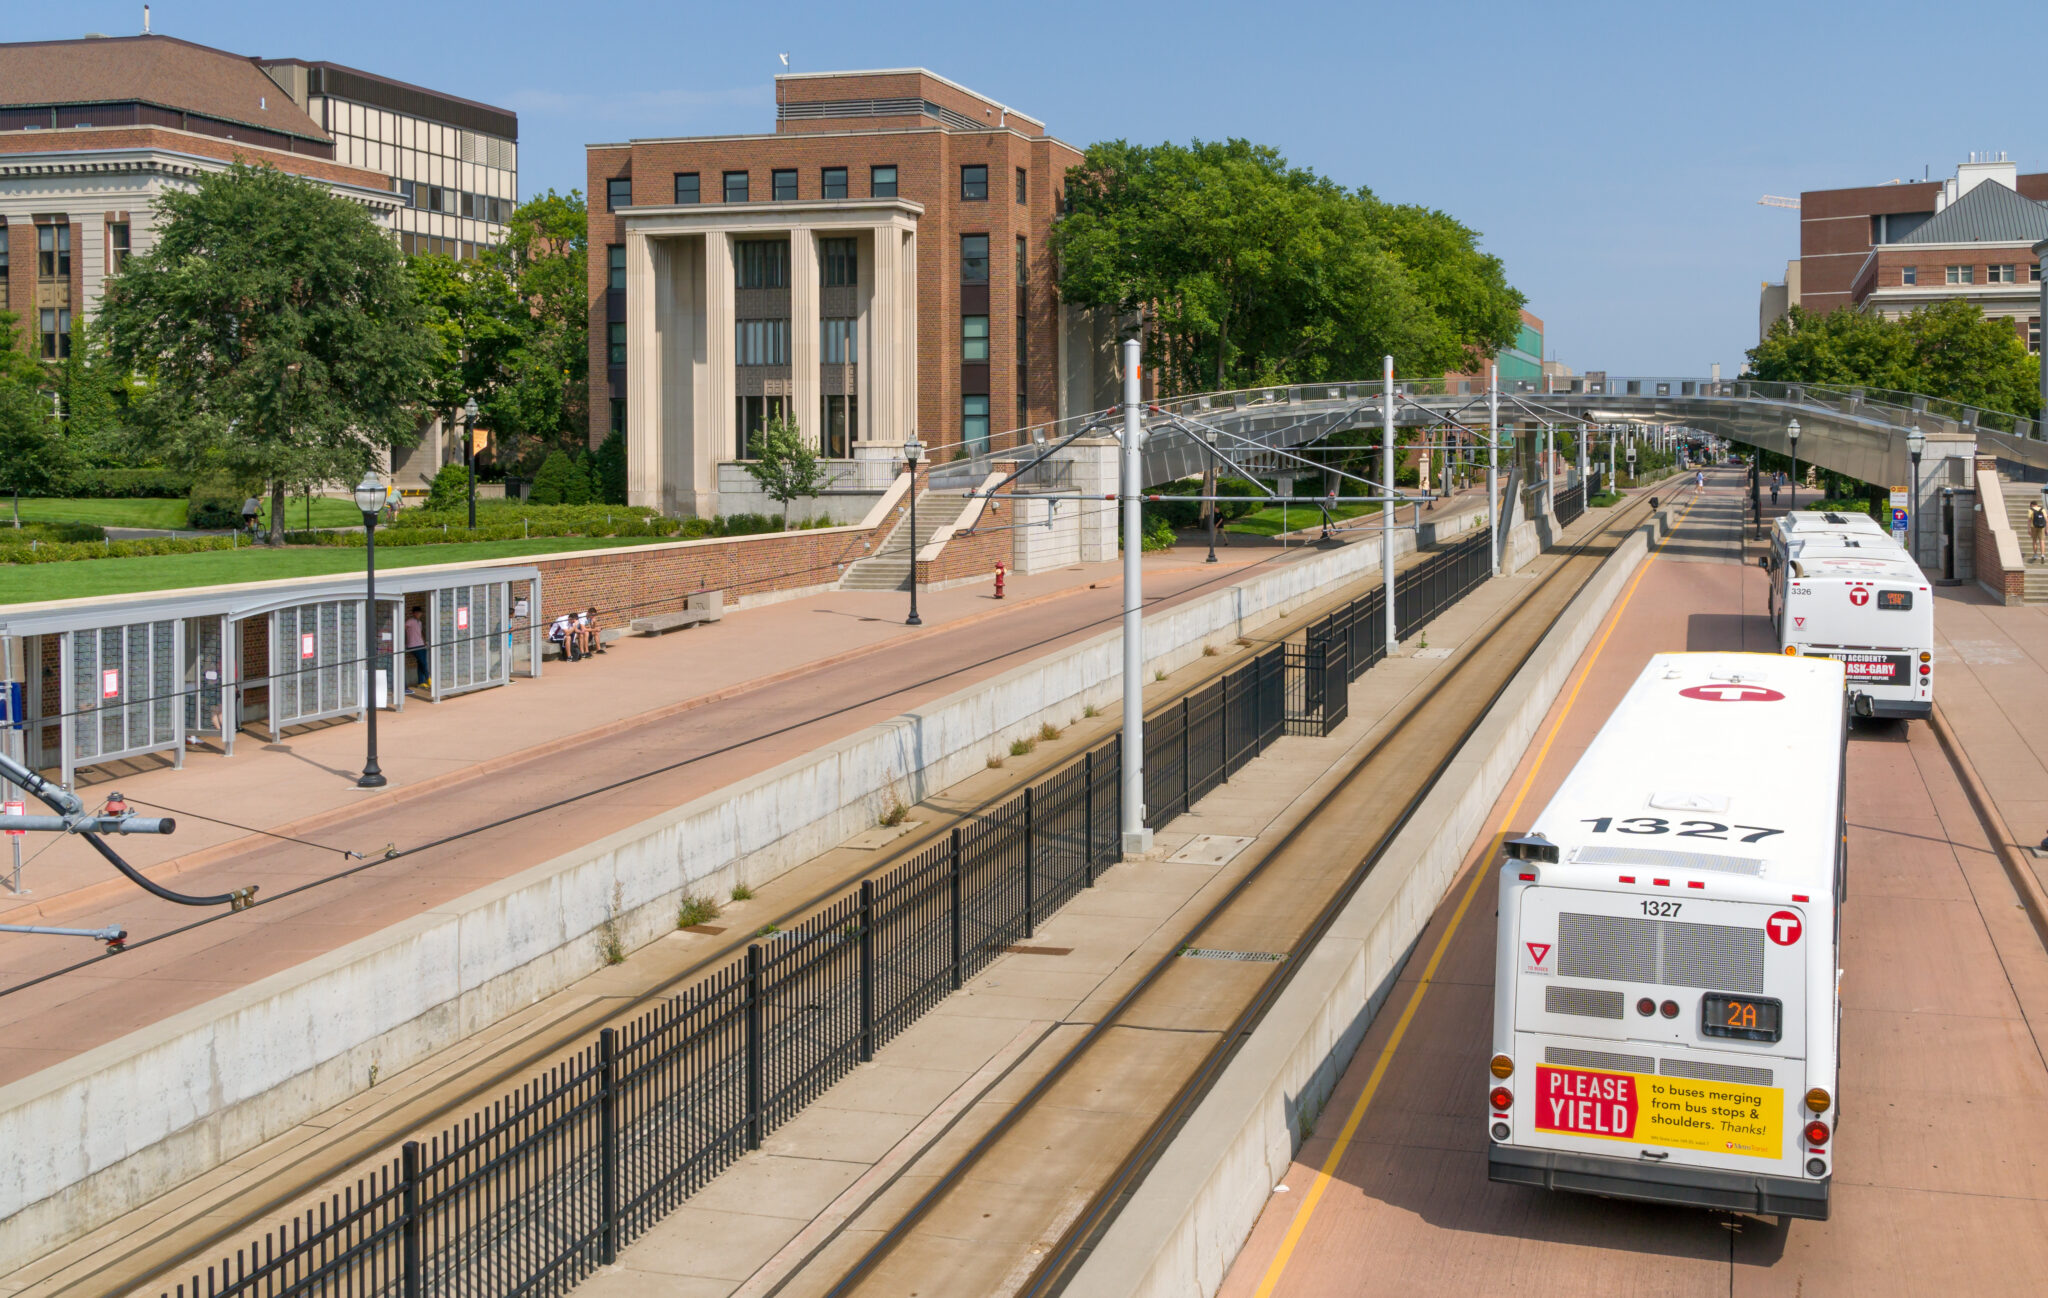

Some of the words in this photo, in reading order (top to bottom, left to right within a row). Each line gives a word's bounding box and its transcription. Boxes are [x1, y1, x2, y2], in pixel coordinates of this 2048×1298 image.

[1791, 588, 1812, 596] 3326
[1847, 654, 1888, 663] ACCIDENT?
[1847, 663, 1895, 674] ASK-GARY
[1580, 817, 1785, 844] 1327
[1640, 901, 1682, 918] 1327
[1727, 1002, 1757, 1028] 2A
[1550, 1072, 1628, 1102] PLEASE
[1651, 1084, 1665, 1094] to
[1669, 1085, 1705, 1099] buses
[1709, 1090, 1762, 1107] merging
[1549, 1098, 1628, 1134] YIELD
[1651, 1098, 1681, 1111] from
[1685, 1100, 1707, 1114] bus
[1711, 1105, 1746, 1120] stops
[1750, 1108, 1760, 1119] &
[1651, 1114, 1715, 1131] shoulders.
[1720, 1120, 1768, 1136] Thanks!
